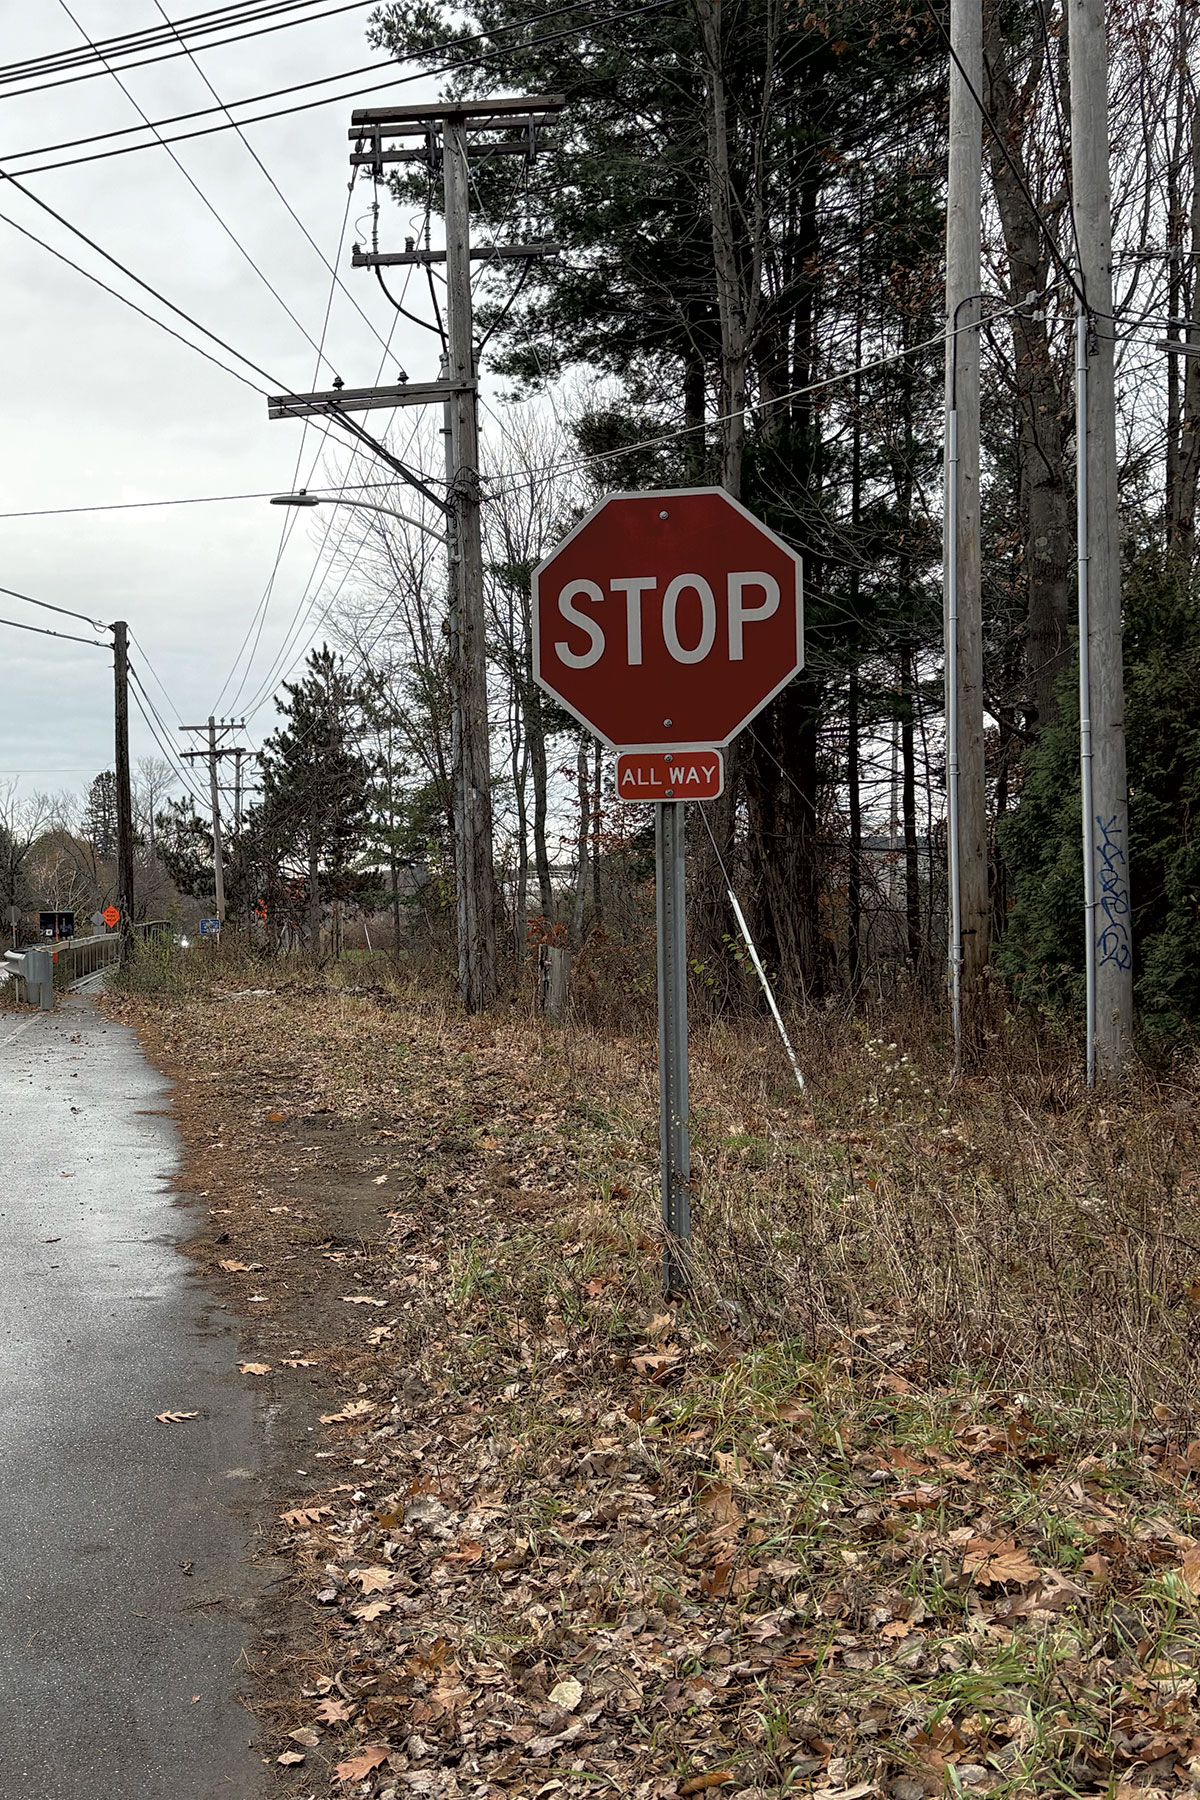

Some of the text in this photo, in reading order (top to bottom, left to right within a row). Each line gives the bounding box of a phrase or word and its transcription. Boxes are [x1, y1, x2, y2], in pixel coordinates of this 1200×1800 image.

[554, 571, 781, 670] STOP
[621, 765, 716, 786] ALL WAY
